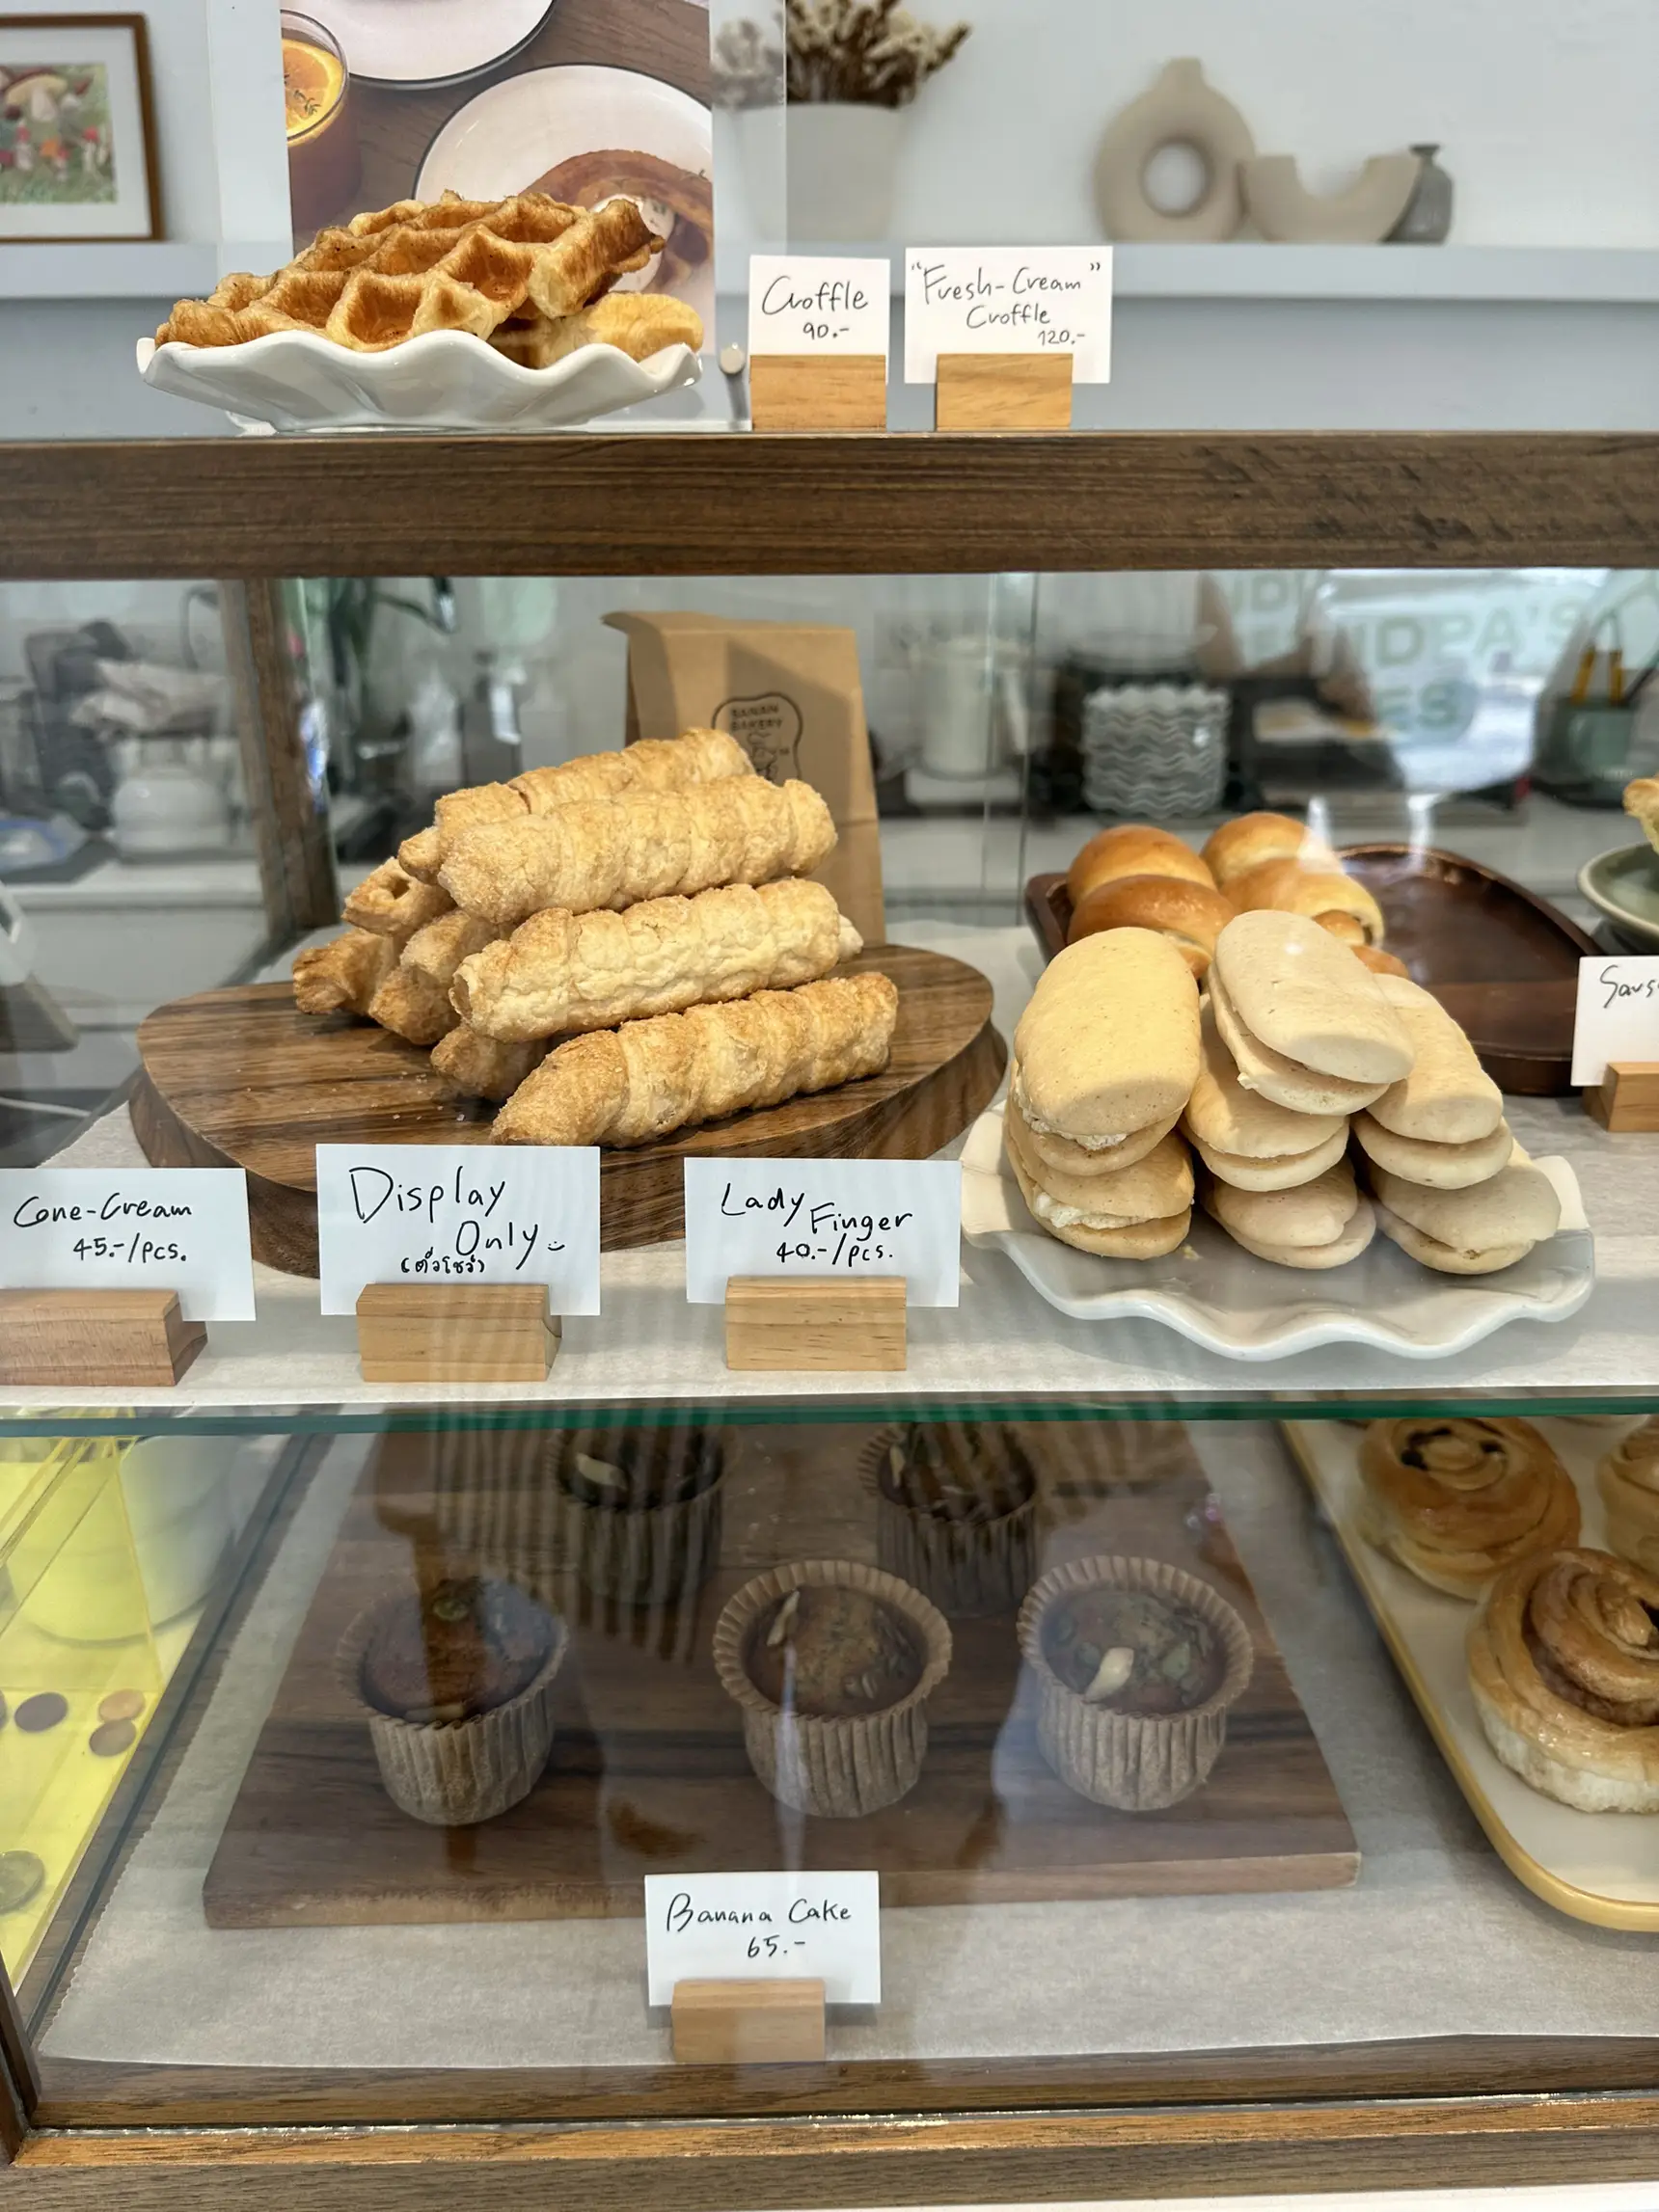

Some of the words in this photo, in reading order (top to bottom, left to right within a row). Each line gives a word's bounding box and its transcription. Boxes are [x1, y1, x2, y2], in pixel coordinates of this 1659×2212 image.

[761, 275, 869, 316] Croffle
[802, 321, 851, 340] 90.-
[965, 302, 1051, 330] Croffle
[1037, 329, 1086, 346] 120.-
[1599, 963, 1659, 1010] Saus
[13, 1191, 193, 1228] Cone-Cream
[348, 1165, 506, 1225] Display
[721, 1182, 805, 1227] Lady
[809, 1201, 913, 1242] Finger
[666, 1892, 774, 1933] Banana
[787, 1898, 852, 1925] Cake
[747, 1934, 806, 1959] 65.-
